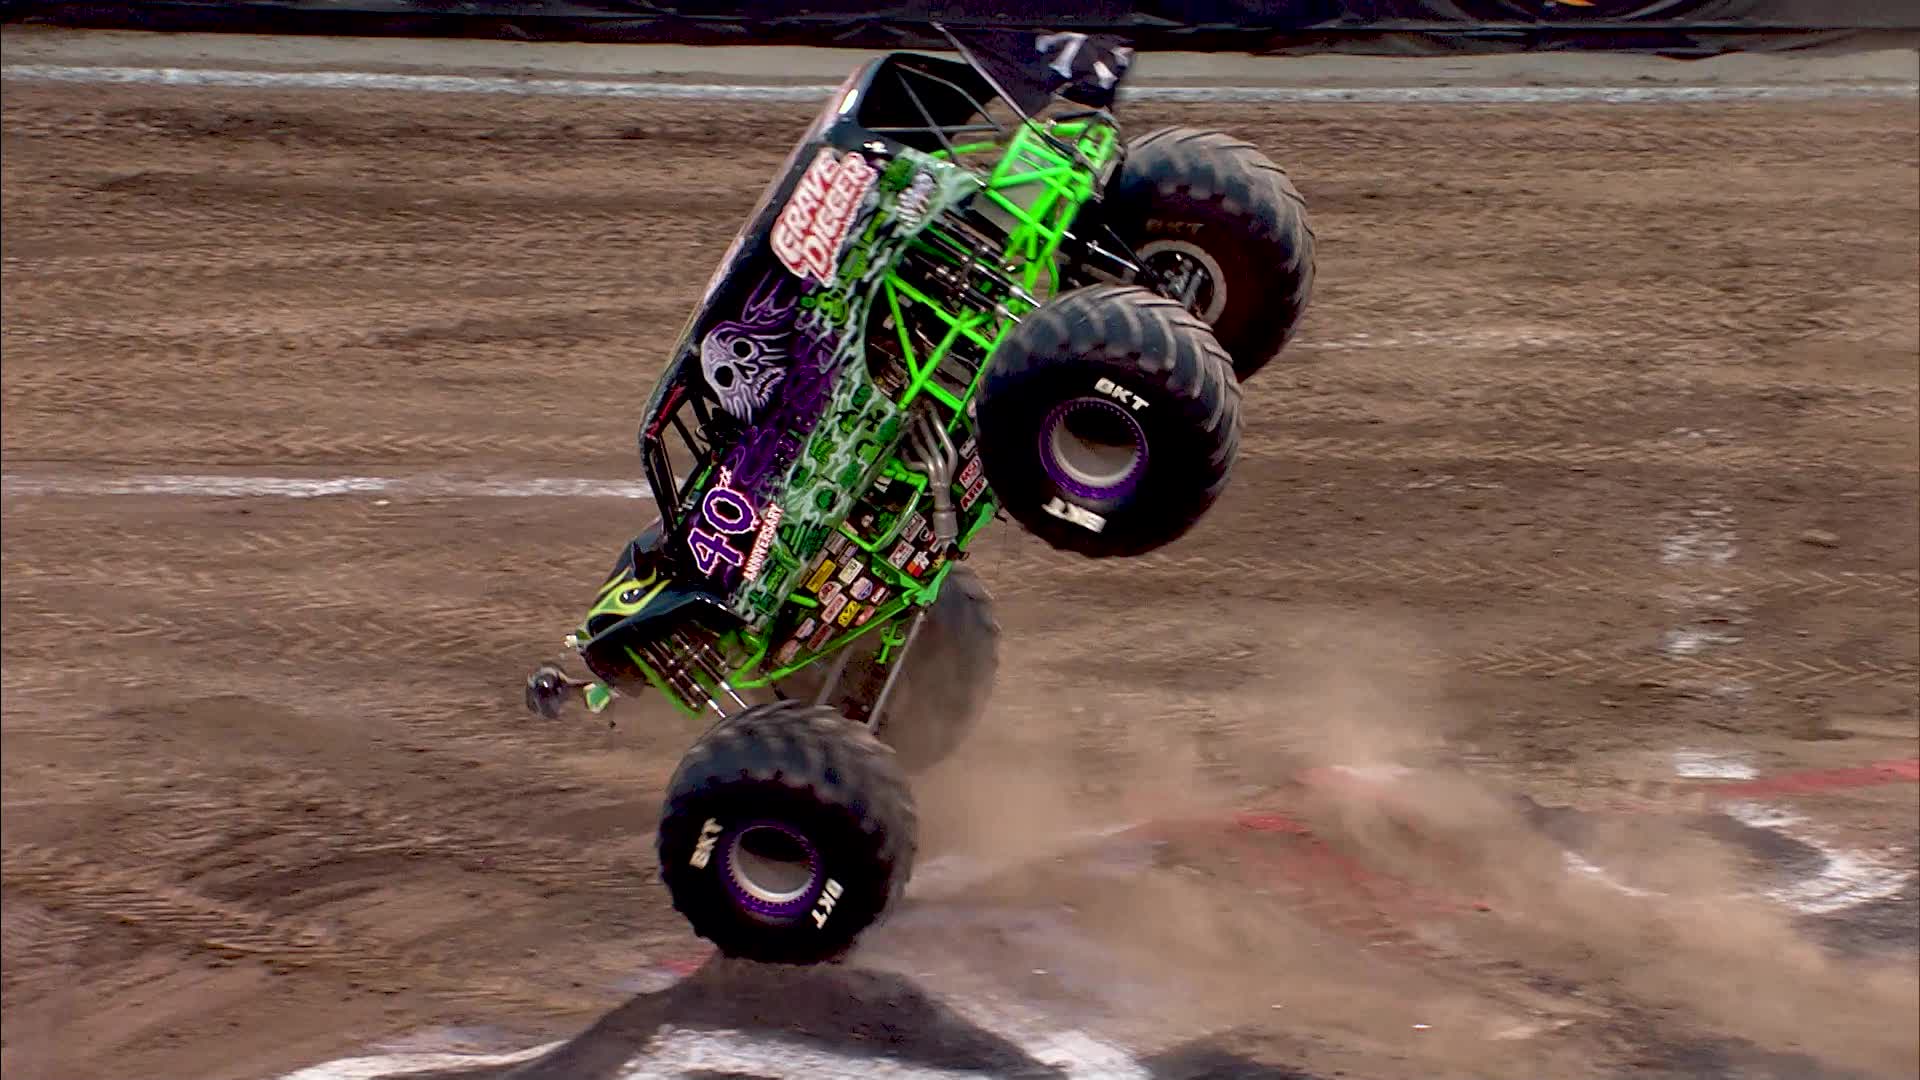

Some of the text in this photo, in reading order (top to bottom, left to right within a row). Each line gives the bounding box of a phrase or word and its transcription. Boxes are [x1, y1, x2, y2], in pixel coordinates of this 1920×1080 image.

[771, 147, 841, 278] GRAVE
[804, 151, 878, 287] DIGGER
[1094, 377, 1150, 411] BKT
[742, 502, 784, 581] ANNIVERSARY
[1041, 496, 1107, 533] BKT
[811, 877, 844, 929] BKT
